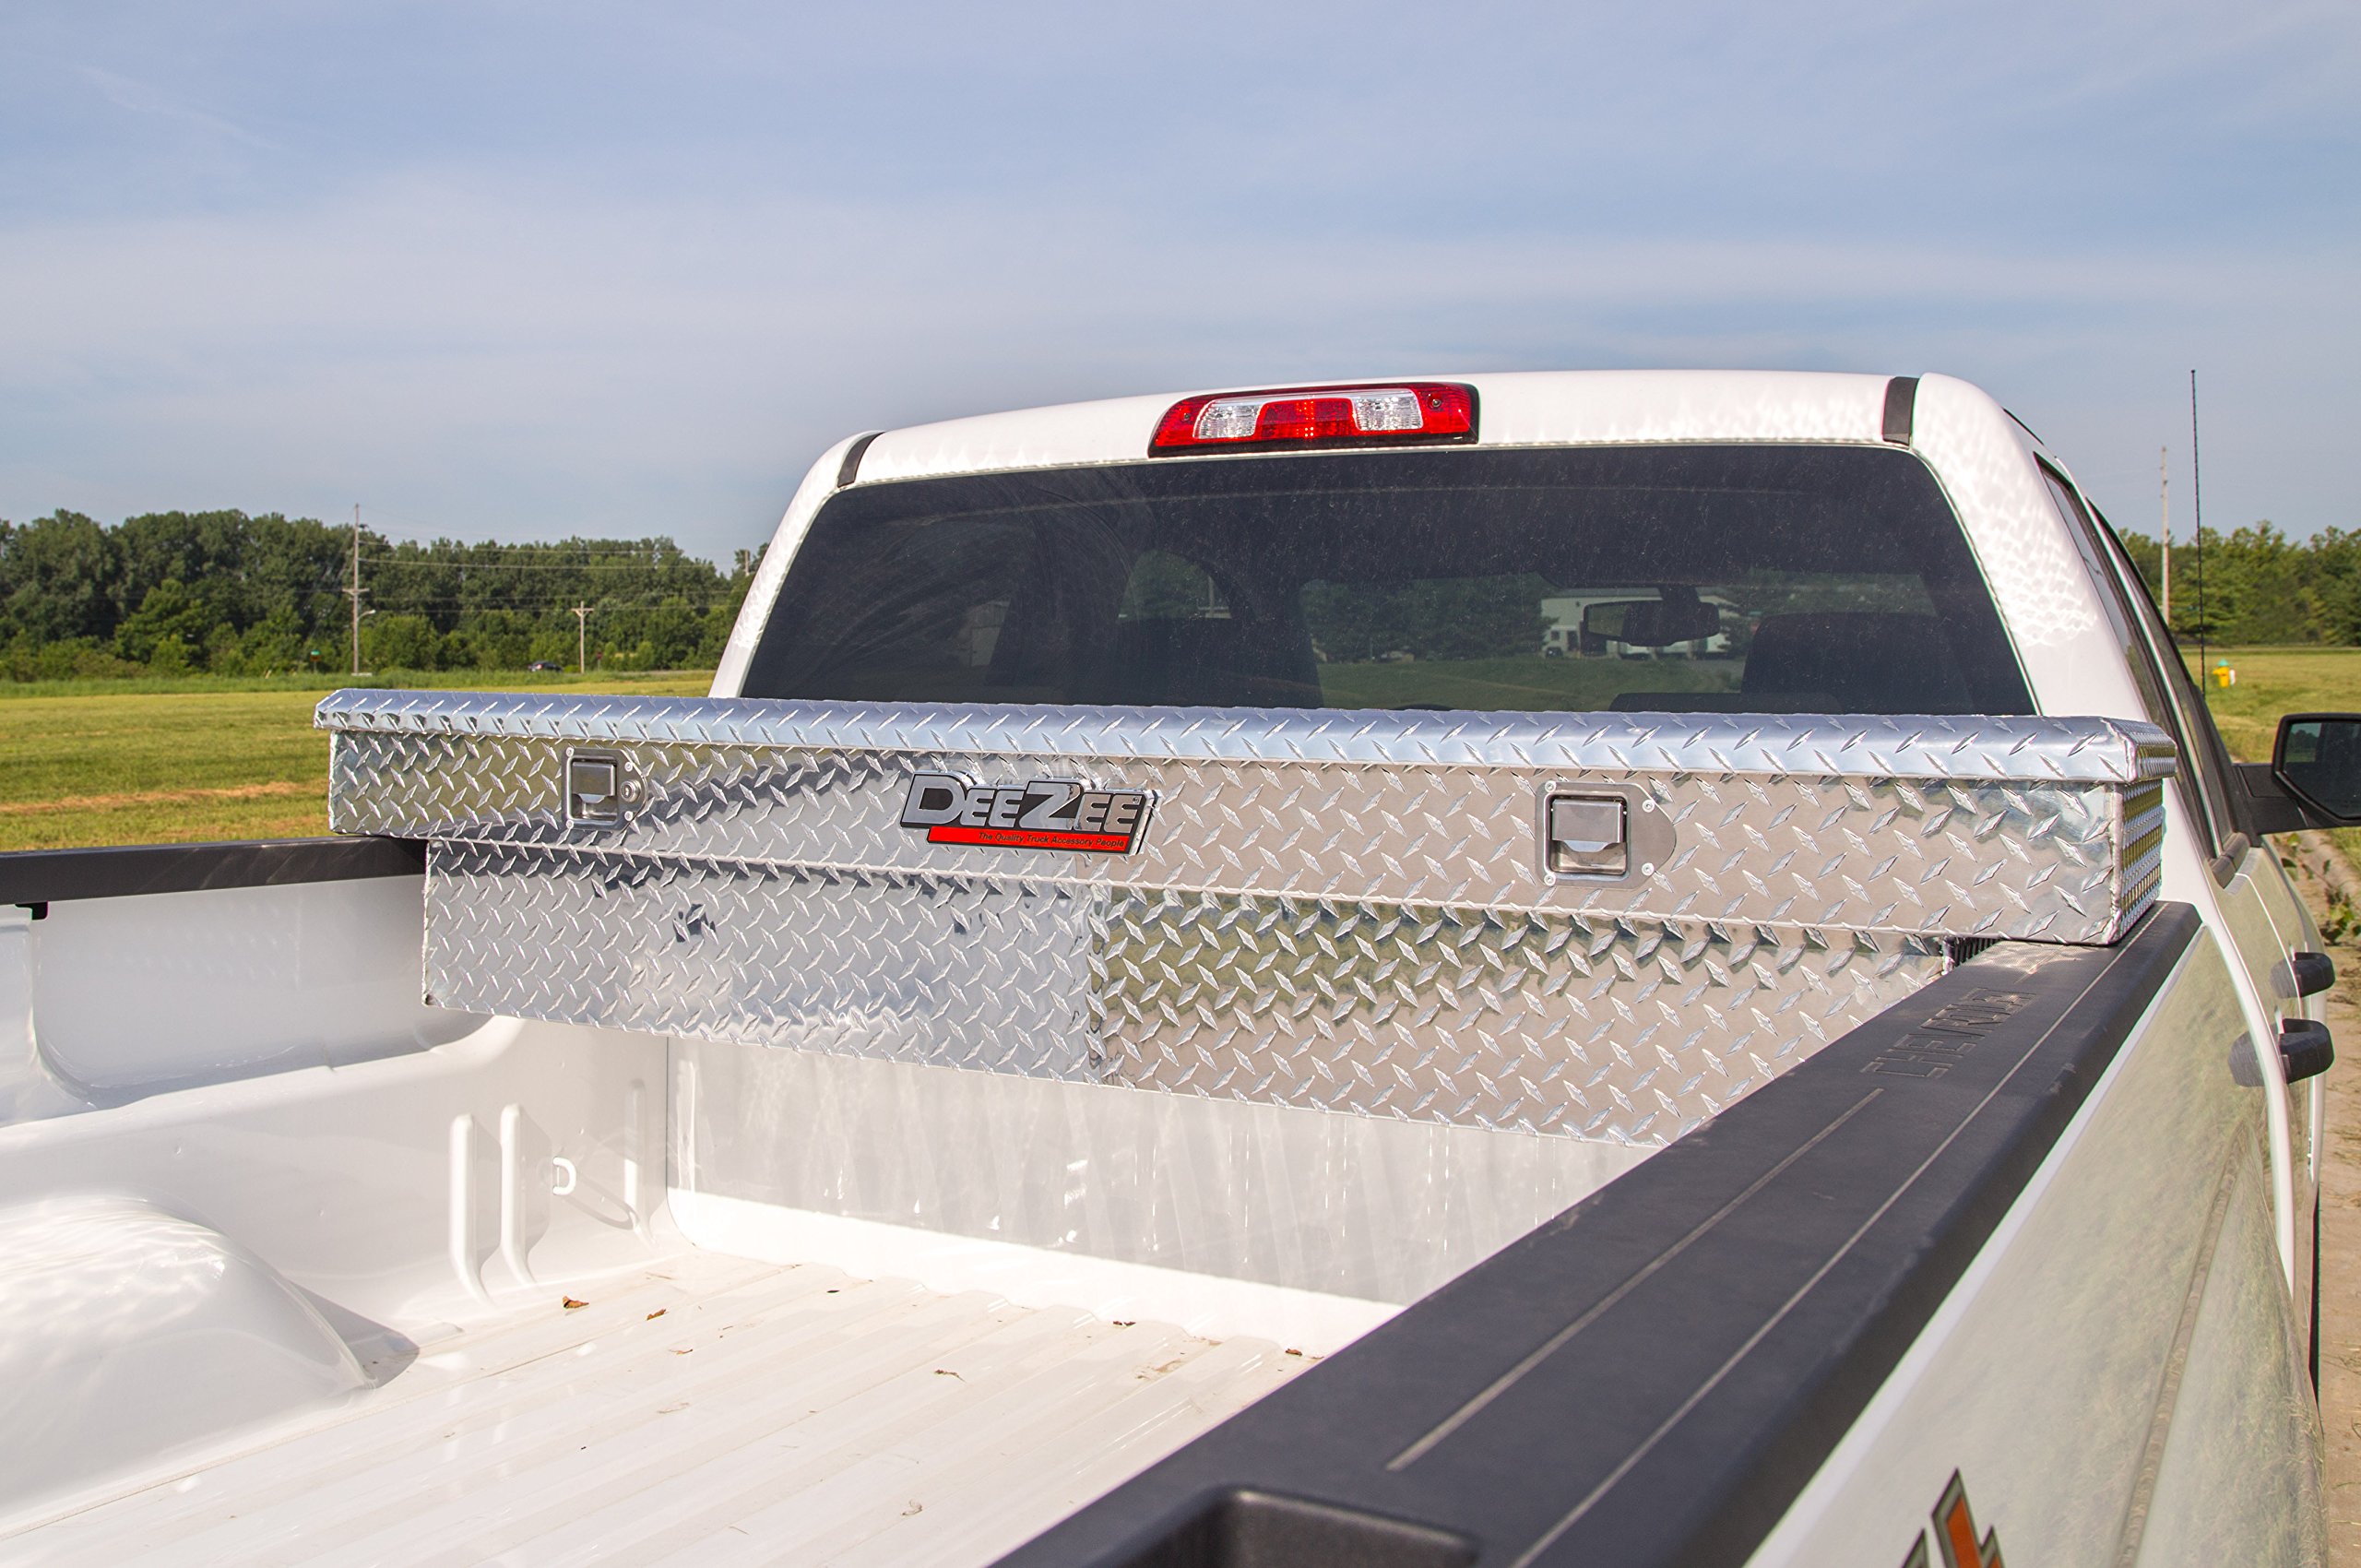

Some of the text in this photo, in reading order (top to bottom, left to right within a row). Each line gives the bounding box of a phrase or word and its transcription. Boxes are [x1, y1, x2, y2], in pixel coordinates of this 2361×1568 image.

[979, 832, 1124, 848] The Quality Truck Accessory People
